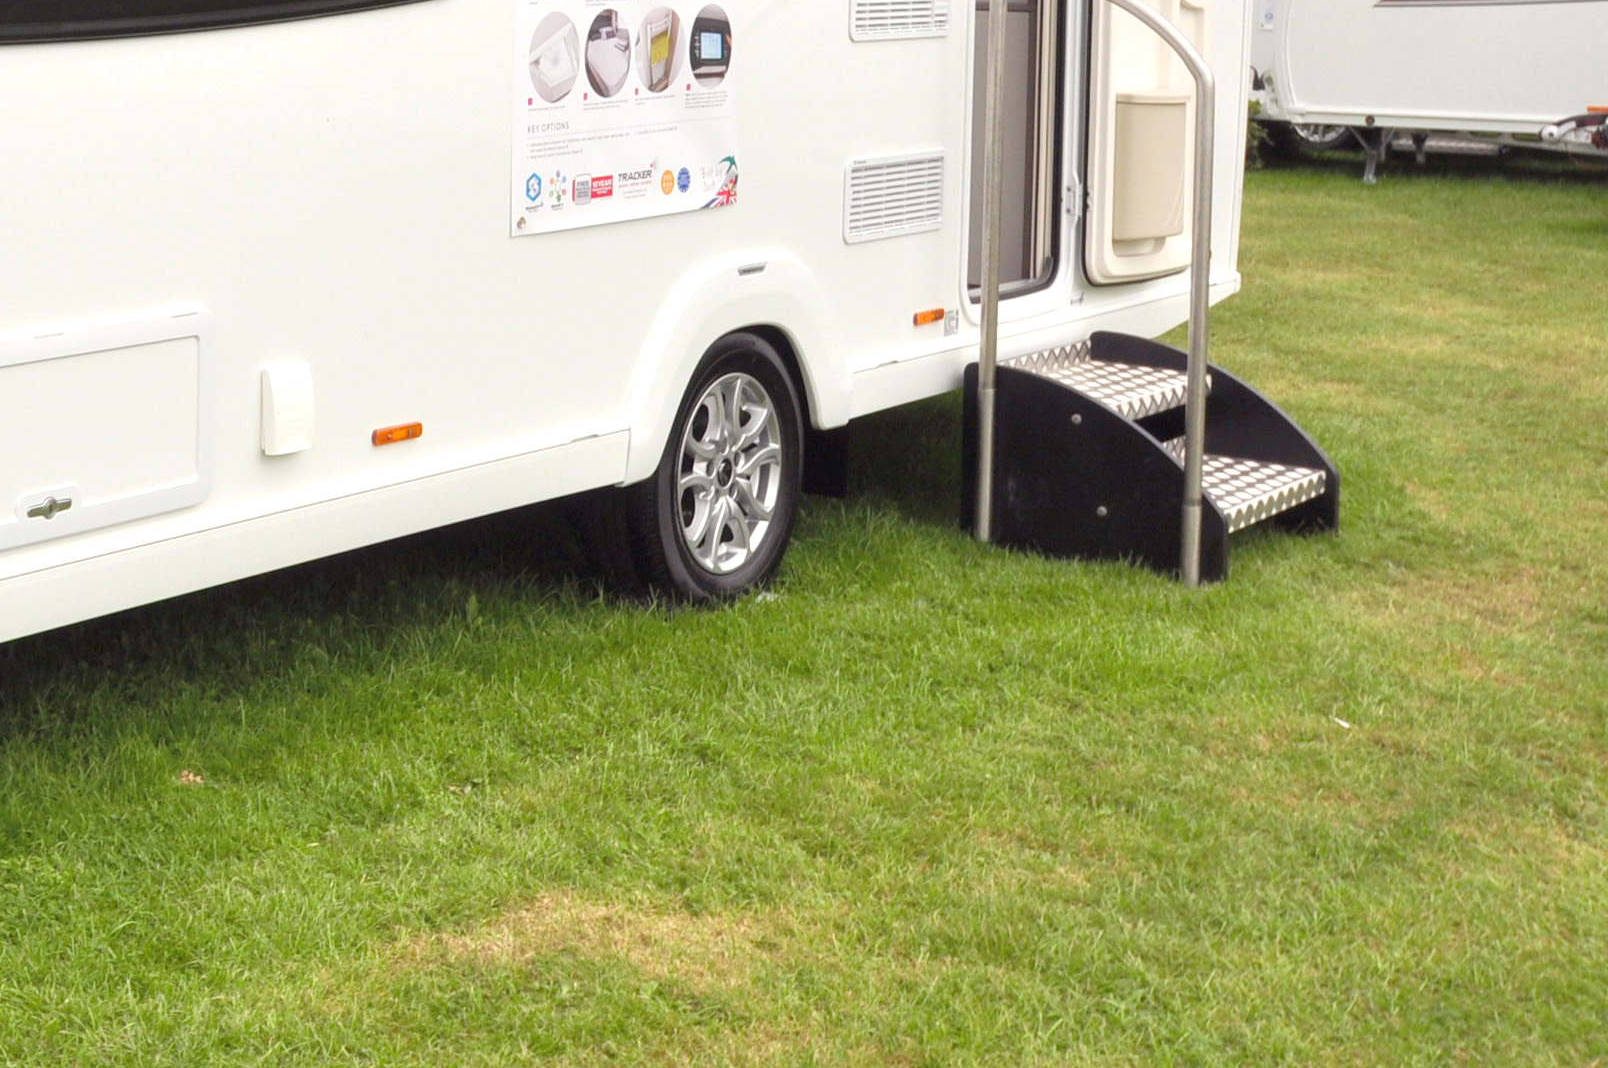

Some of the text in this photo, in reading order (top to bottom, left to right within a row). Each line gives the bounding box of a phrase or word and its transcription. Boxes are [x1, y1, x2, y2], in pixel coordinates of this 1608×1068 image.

[527, 121, 570, 133] KEY OPTIONS
[618, 169, 652, 182] TRACKER
